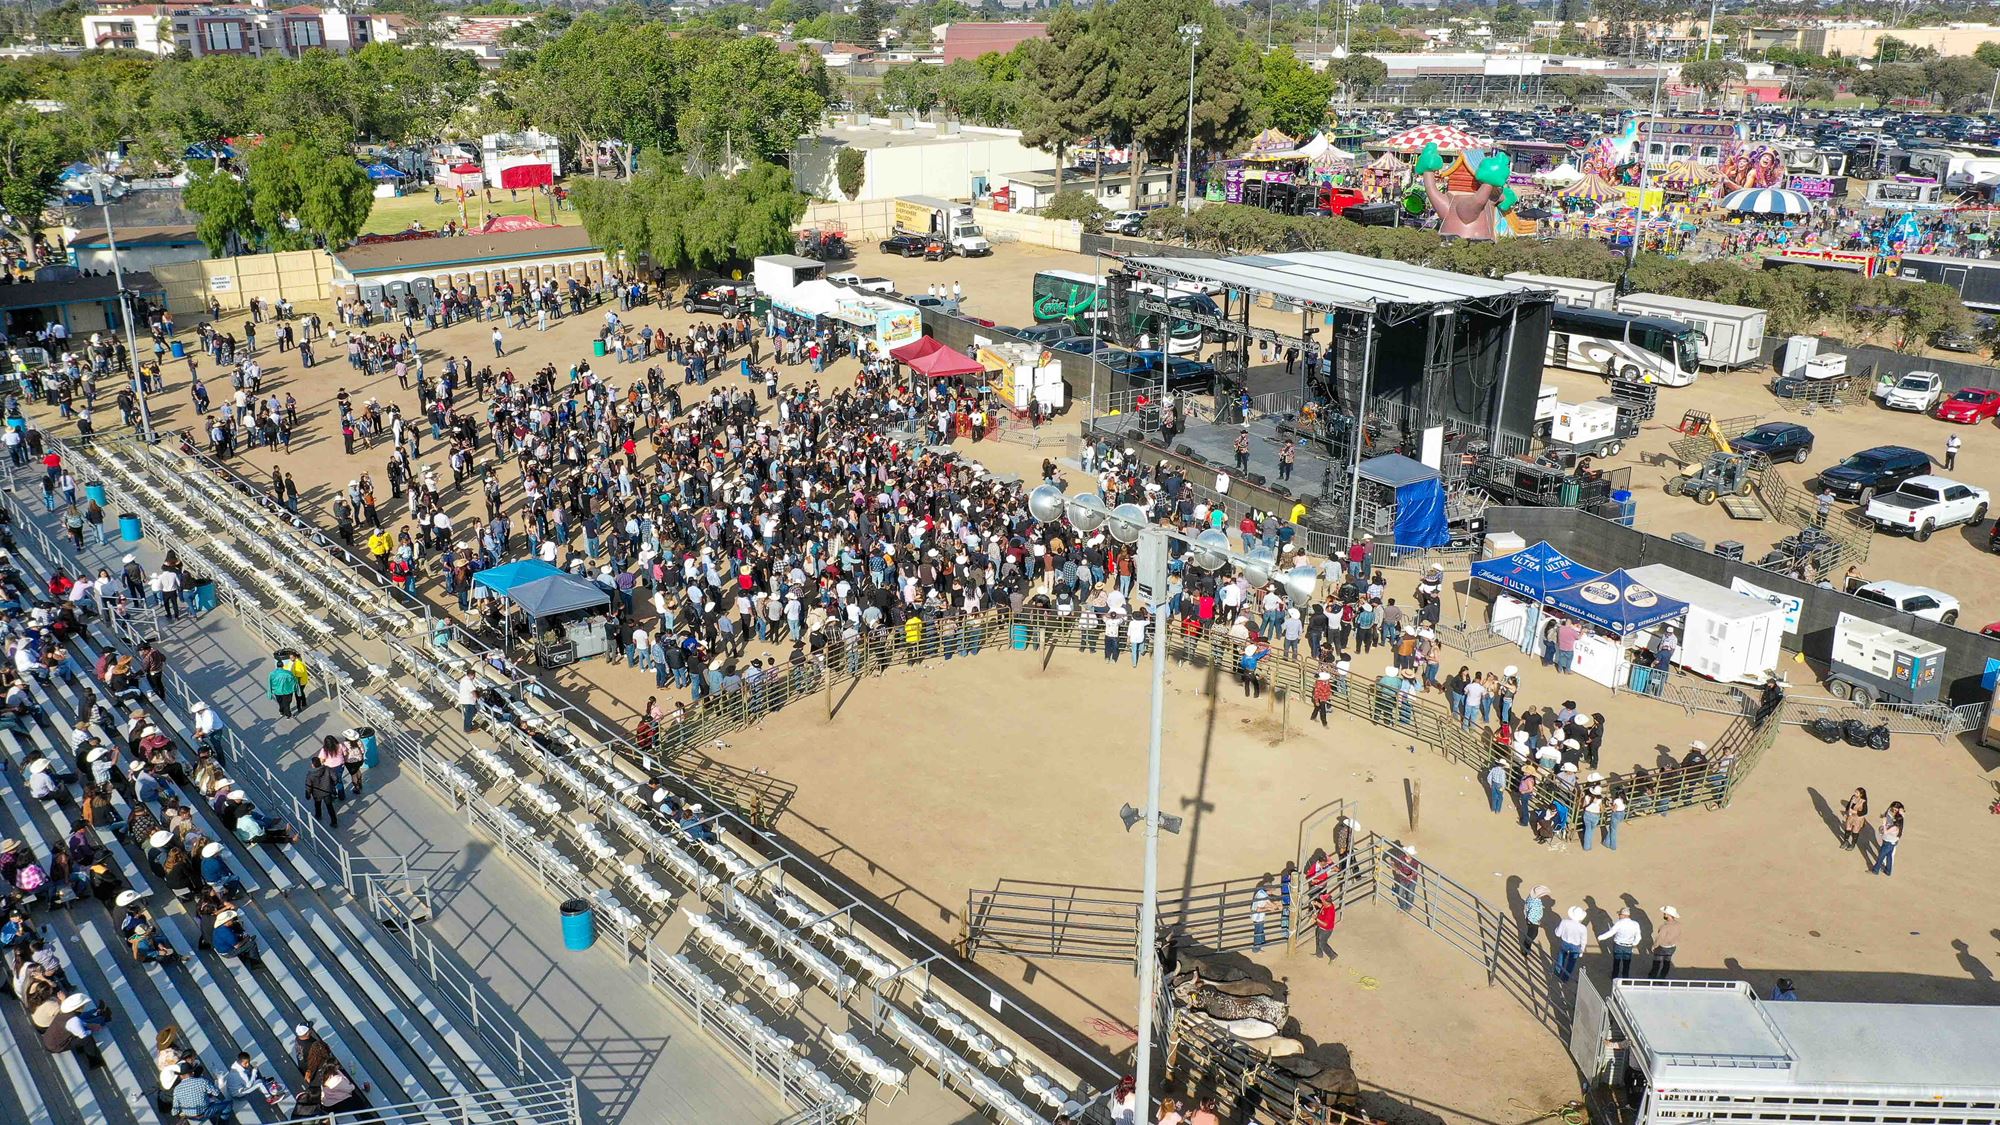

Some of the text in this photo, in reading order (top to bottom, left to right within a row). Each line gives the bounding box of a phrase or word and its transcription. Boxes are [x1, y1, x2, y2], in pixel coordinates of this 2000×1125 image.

[1512, 555, 1541, 572] ULTRA
[1545, 560, 1572, 572] ULTRA
[1478, 569, 1536, 596] Michelob ULTRA
[1558, 602, 1608, 624] ESTRELLA JALISCO
[1637, 616, 1660, 627] ESTRELLA
[1574, 642, 1594, 656] LTRA
